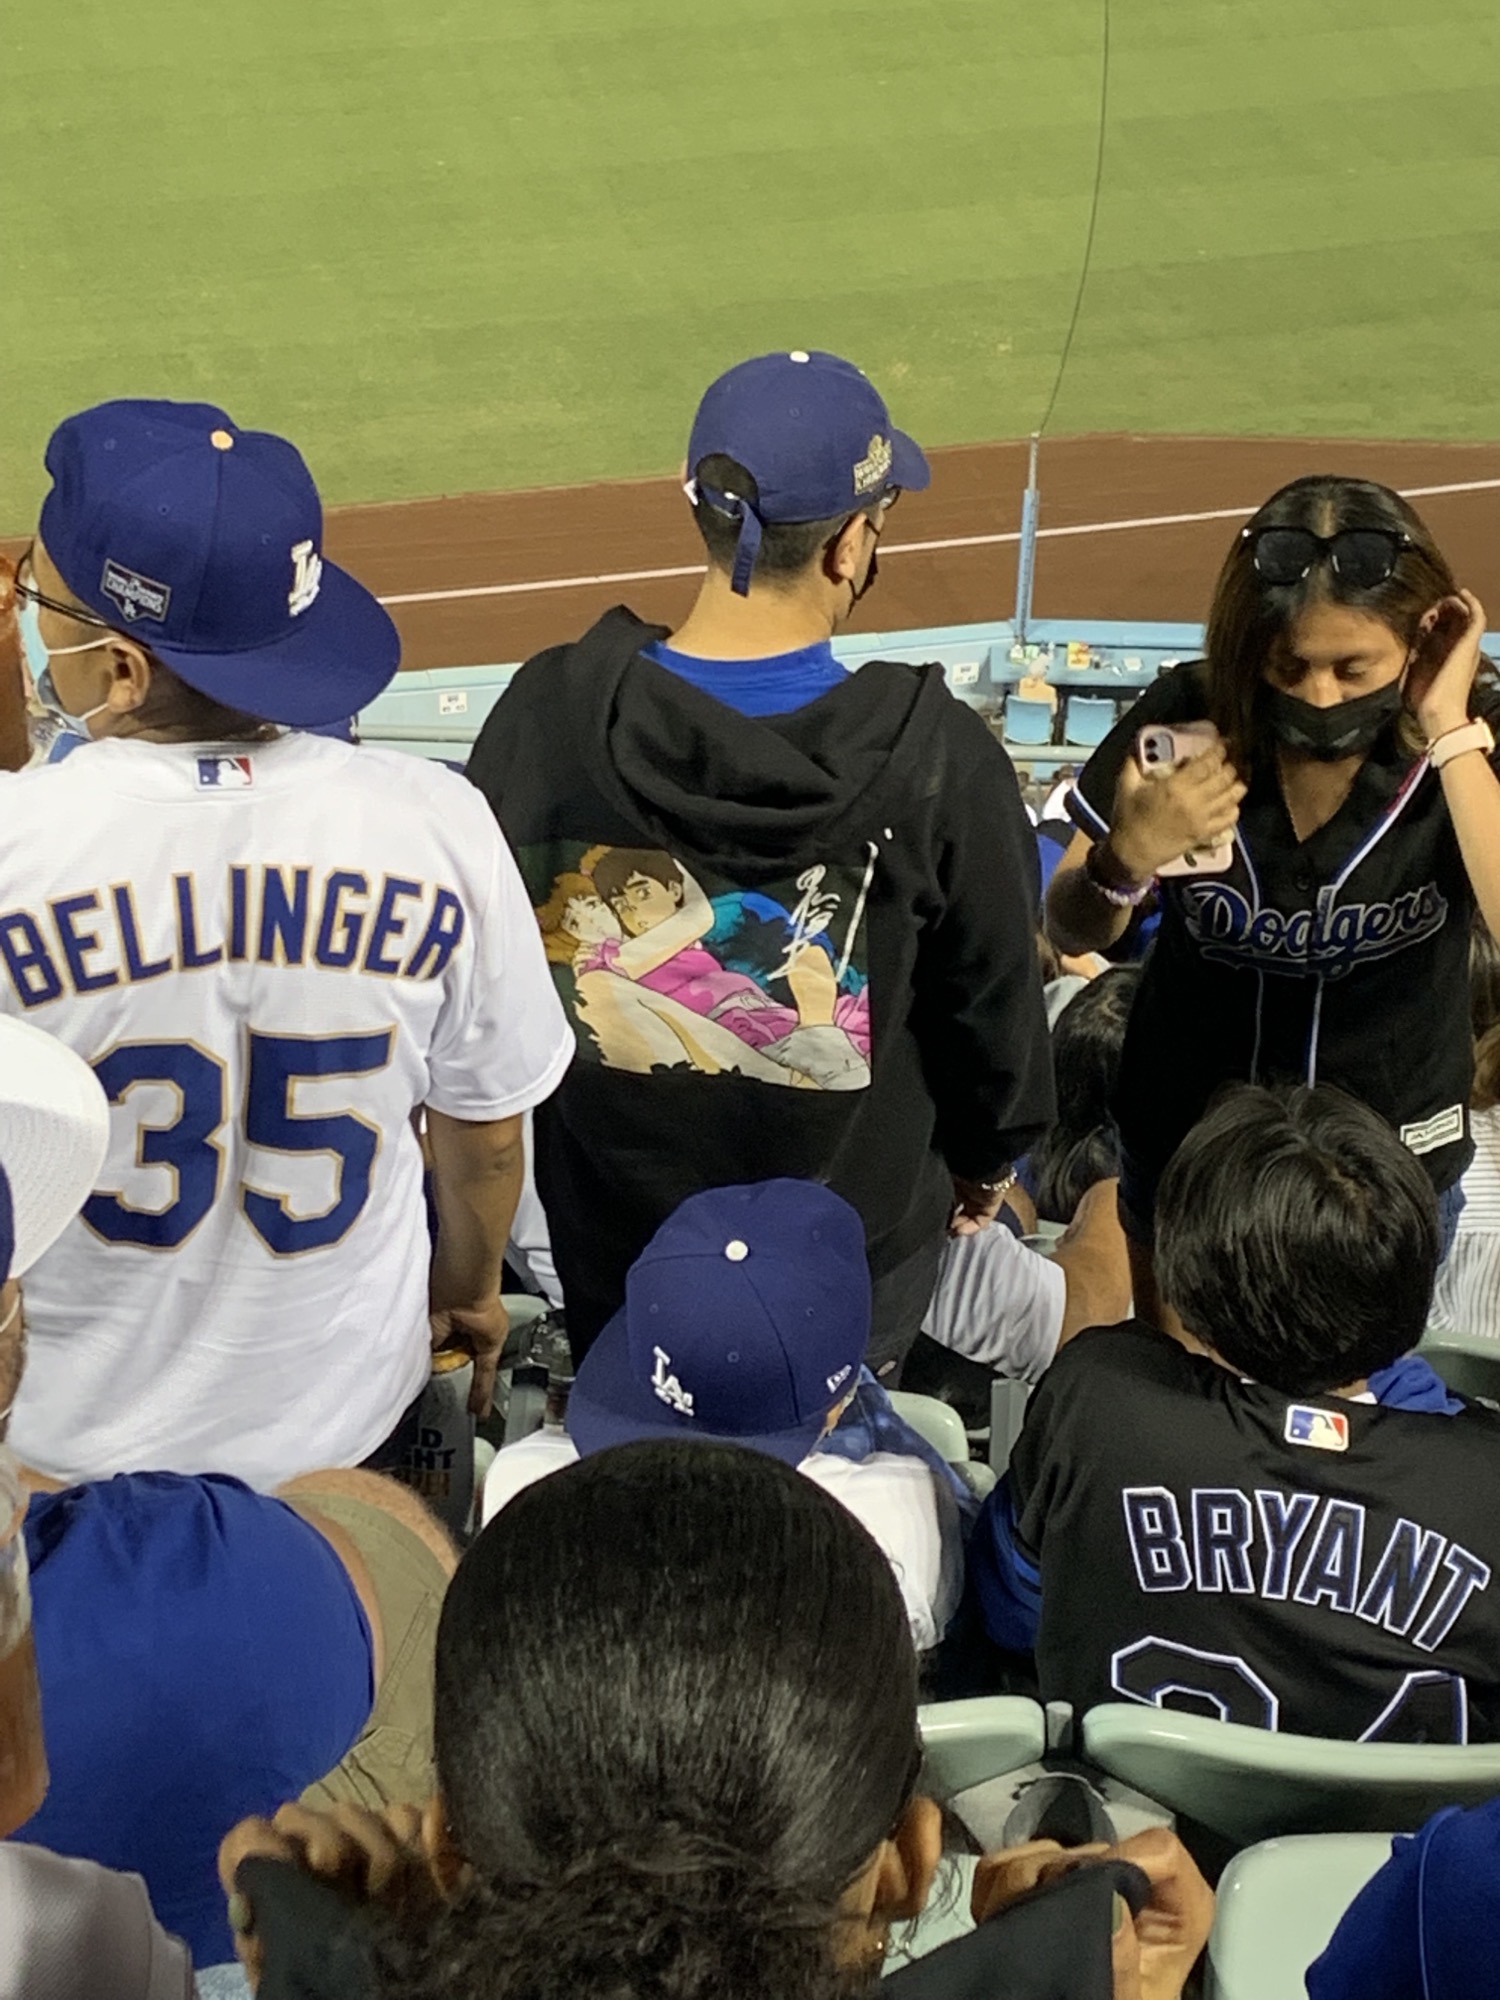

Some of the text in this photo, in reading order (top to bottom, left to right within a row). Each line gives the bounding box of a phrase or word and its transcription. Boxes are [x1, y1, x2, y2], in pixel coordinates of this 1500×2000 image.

[0, 863, 467, 1013] BELLINGER
[1183, 880, 1449, 981] Dodgers
[79, 1023, 398, 1260] 35
[650, 1345, 695, 1417] LA
[1122, 1486, 1492, 1653] BRYANT
